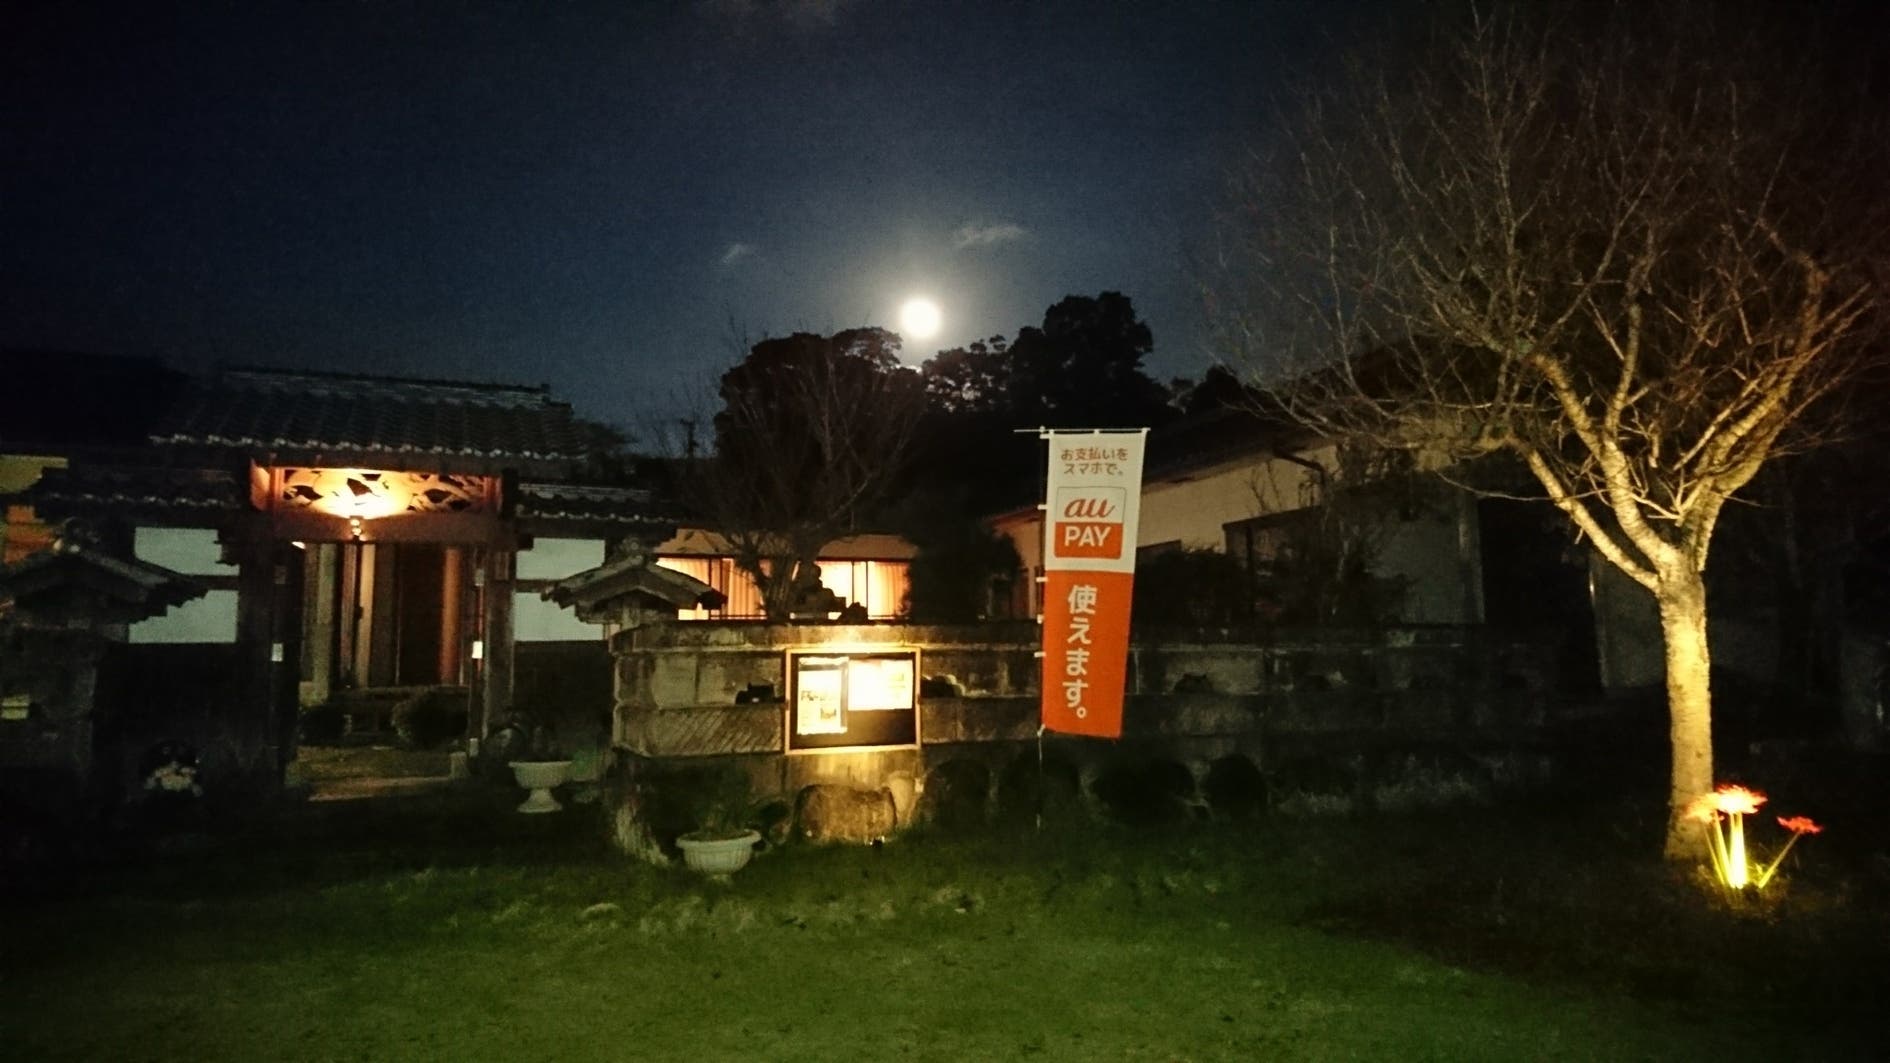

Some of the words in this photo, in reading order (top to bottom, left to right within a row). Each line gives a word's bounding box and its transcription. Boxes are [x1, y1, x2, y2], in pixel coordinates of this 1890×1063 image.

[1061, 447, 1128, 461] お支払いを
[1064, 462, 1124, 476] スマホで。
[1064, 498, 1116, 518] au
[1064, 526, 1112, 547] PAY
[1062, 584, 1098, 719] 使えます。
